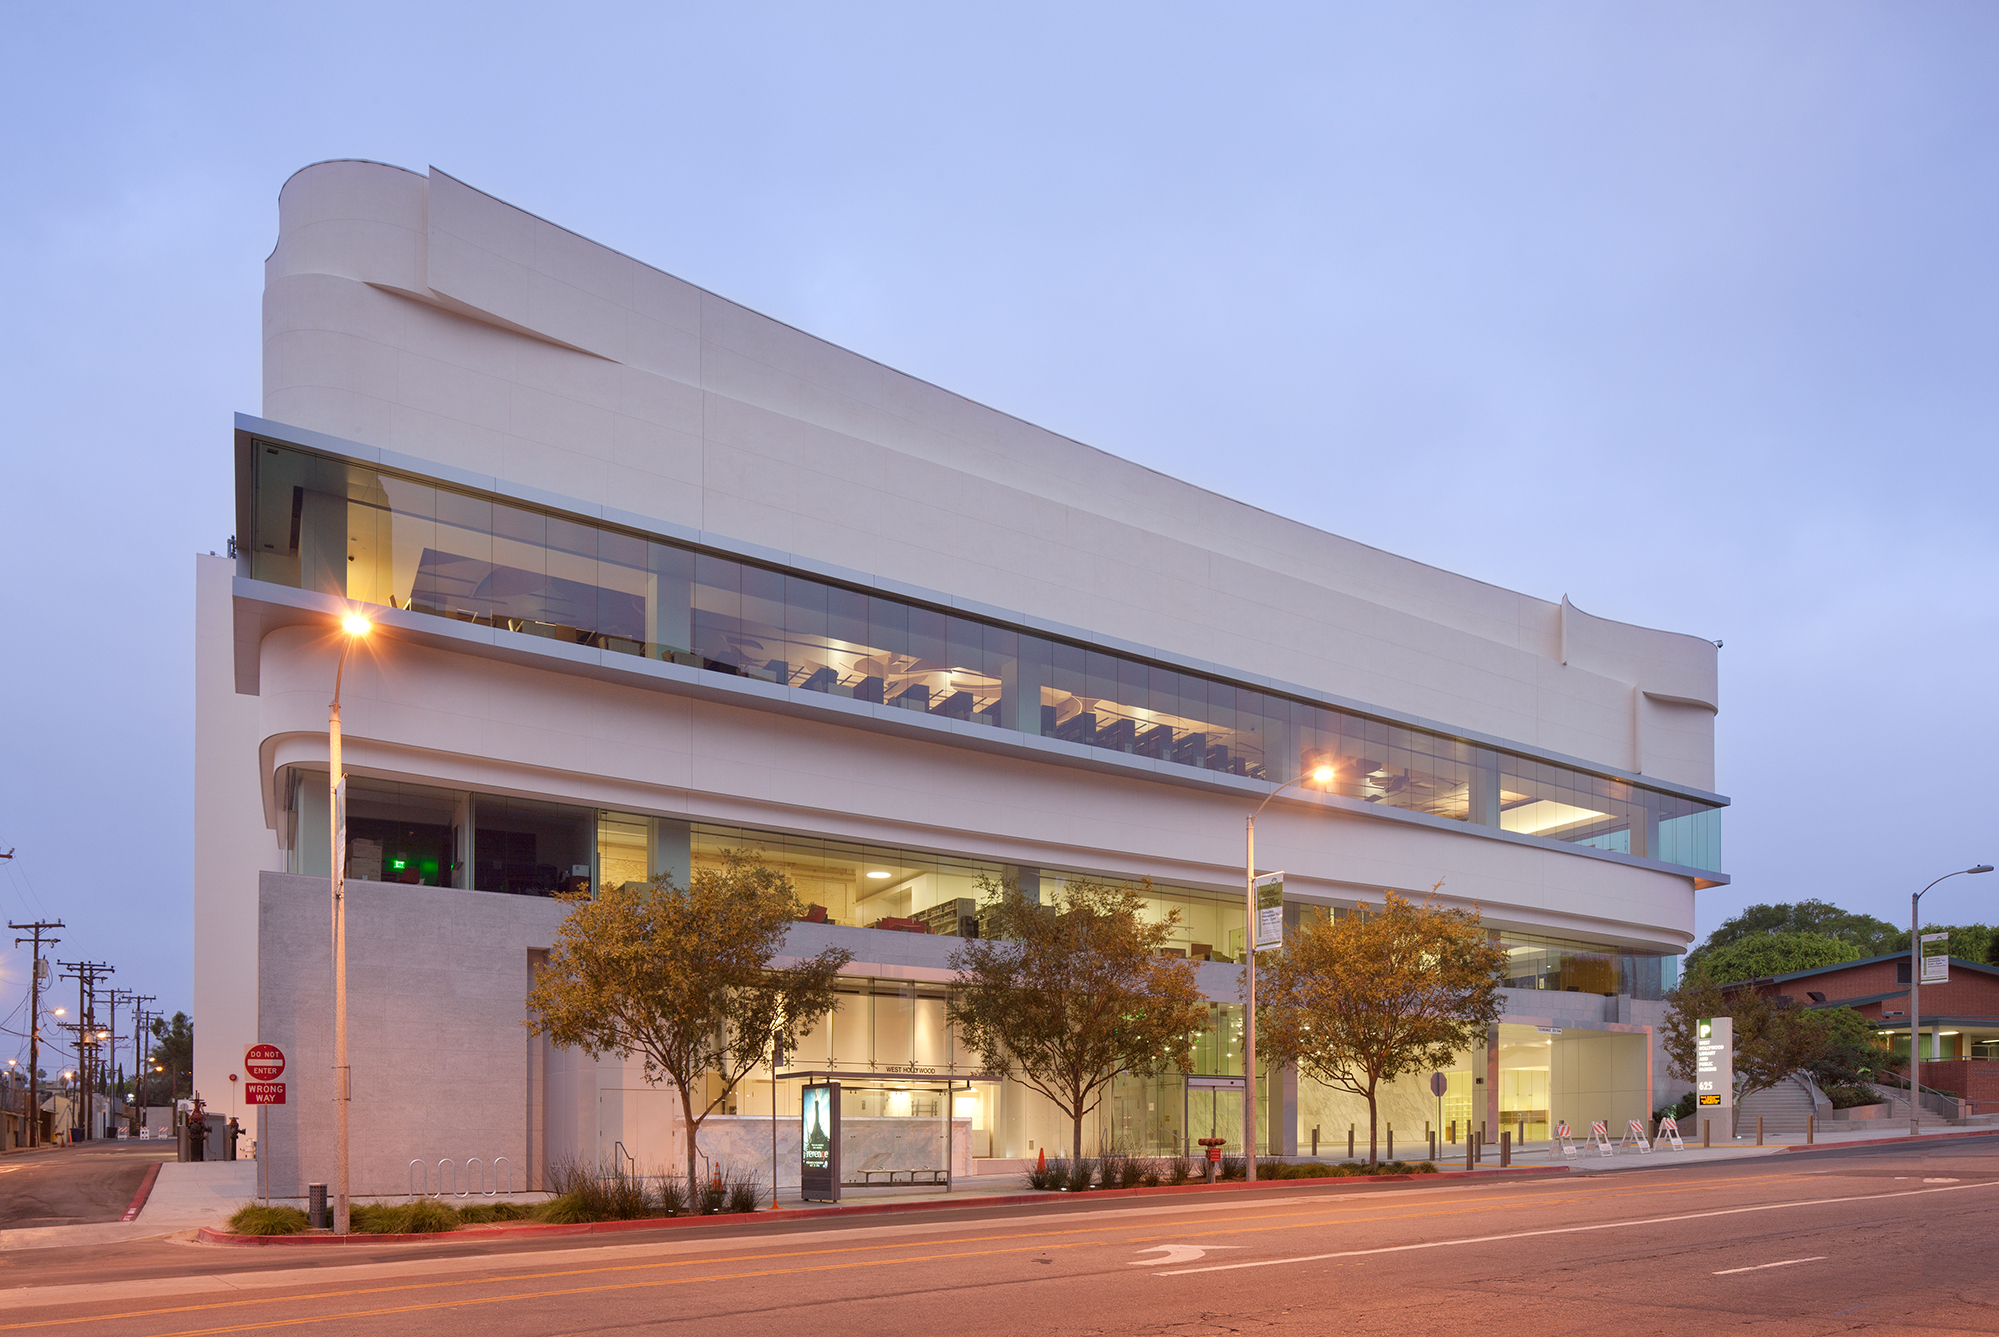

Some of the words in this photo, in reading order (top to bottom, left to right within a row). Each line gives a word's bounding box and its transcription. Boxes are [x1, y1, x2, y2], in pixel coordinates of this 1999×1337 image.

[1700, 1024, 1711, 1038] P
[248, 1085, 283, 1093] WRONG
[1699, 1082, 1713, 1090] 625
[256, 1094, 276, 1102] WAY
